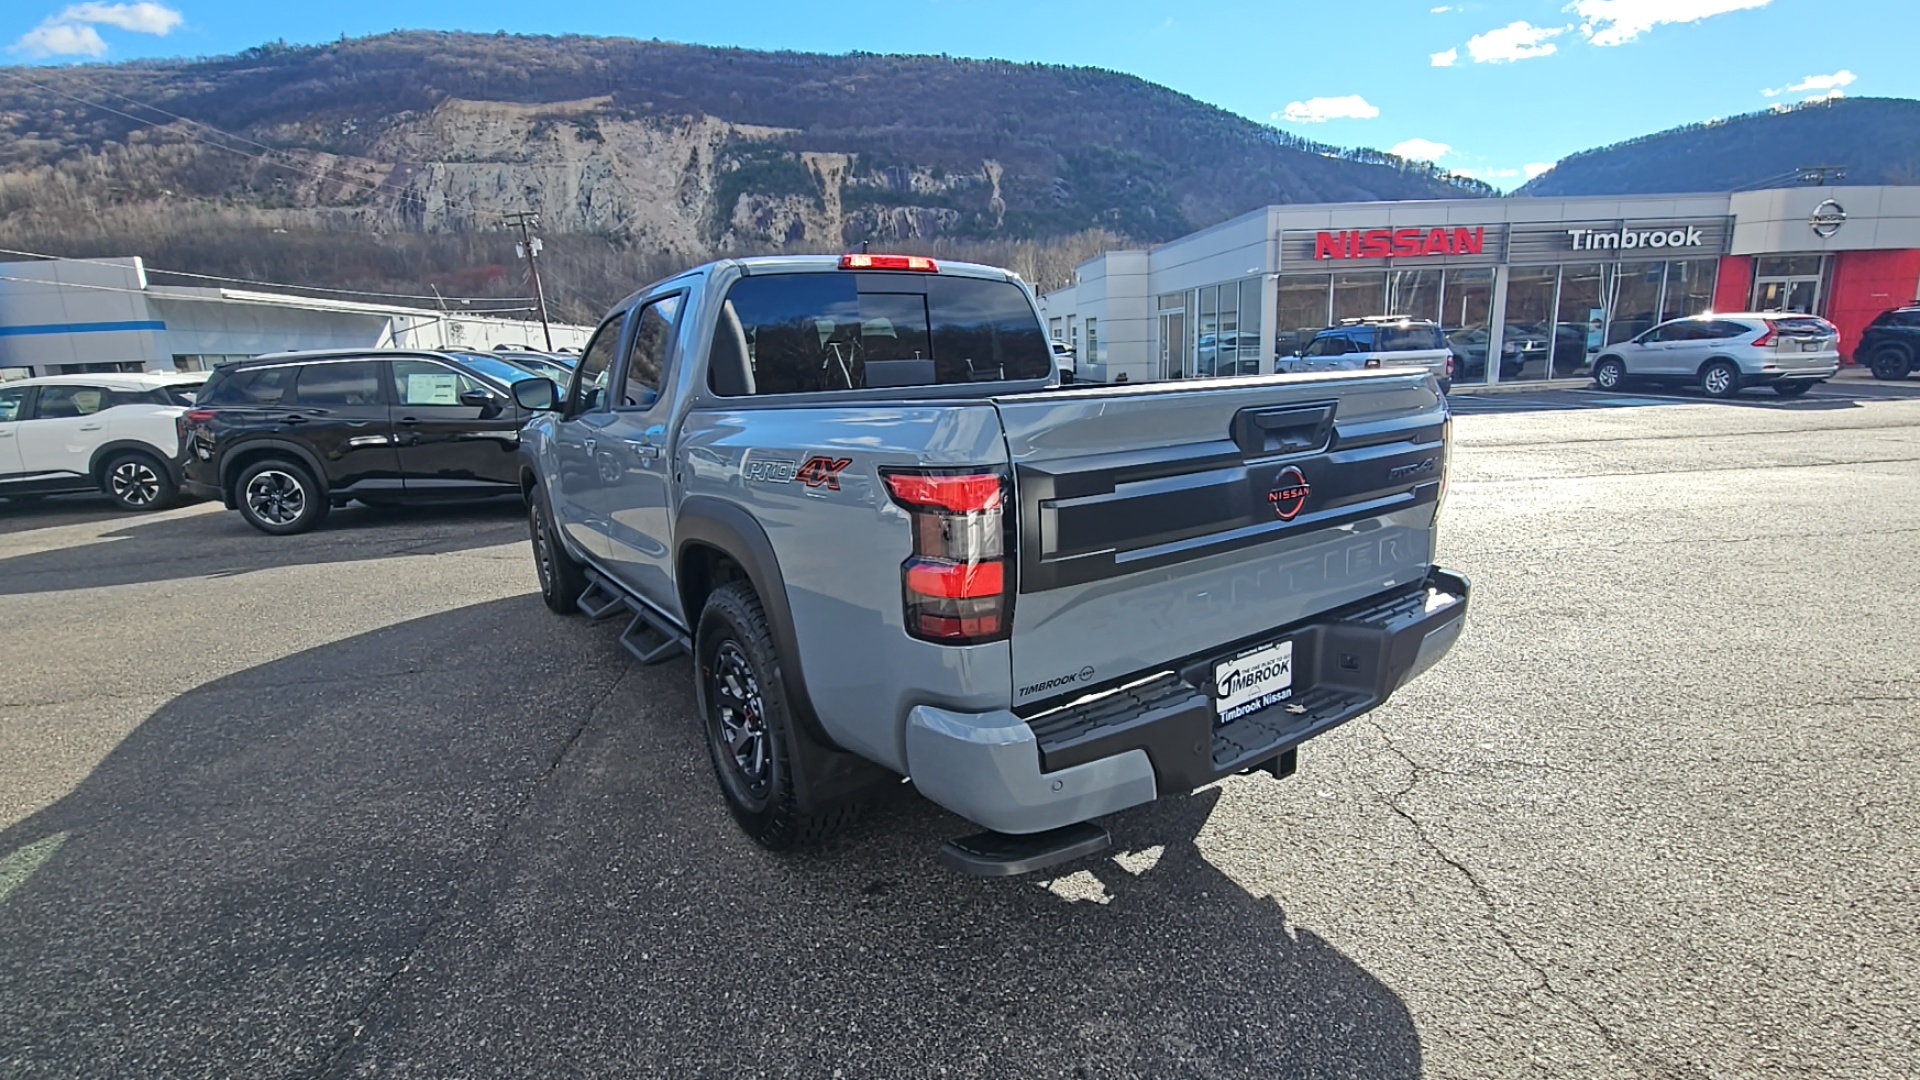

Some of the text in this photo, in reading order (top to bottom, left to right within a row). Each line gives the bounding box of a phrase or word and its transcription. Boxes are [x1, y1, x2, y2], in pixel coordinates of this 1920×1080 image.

[1314, 226, 1484, 260] NISSAN
[1567, 225, 1703, 251] Timbrook
[1268, 487, 1310, 502] NISSAN
[1019, 672, 1078, 697] TIMBROOK
[1218, 659, 1290, 700] TIMBROOK
[1220, 688, 1292, 724] Timbrook Nissan
